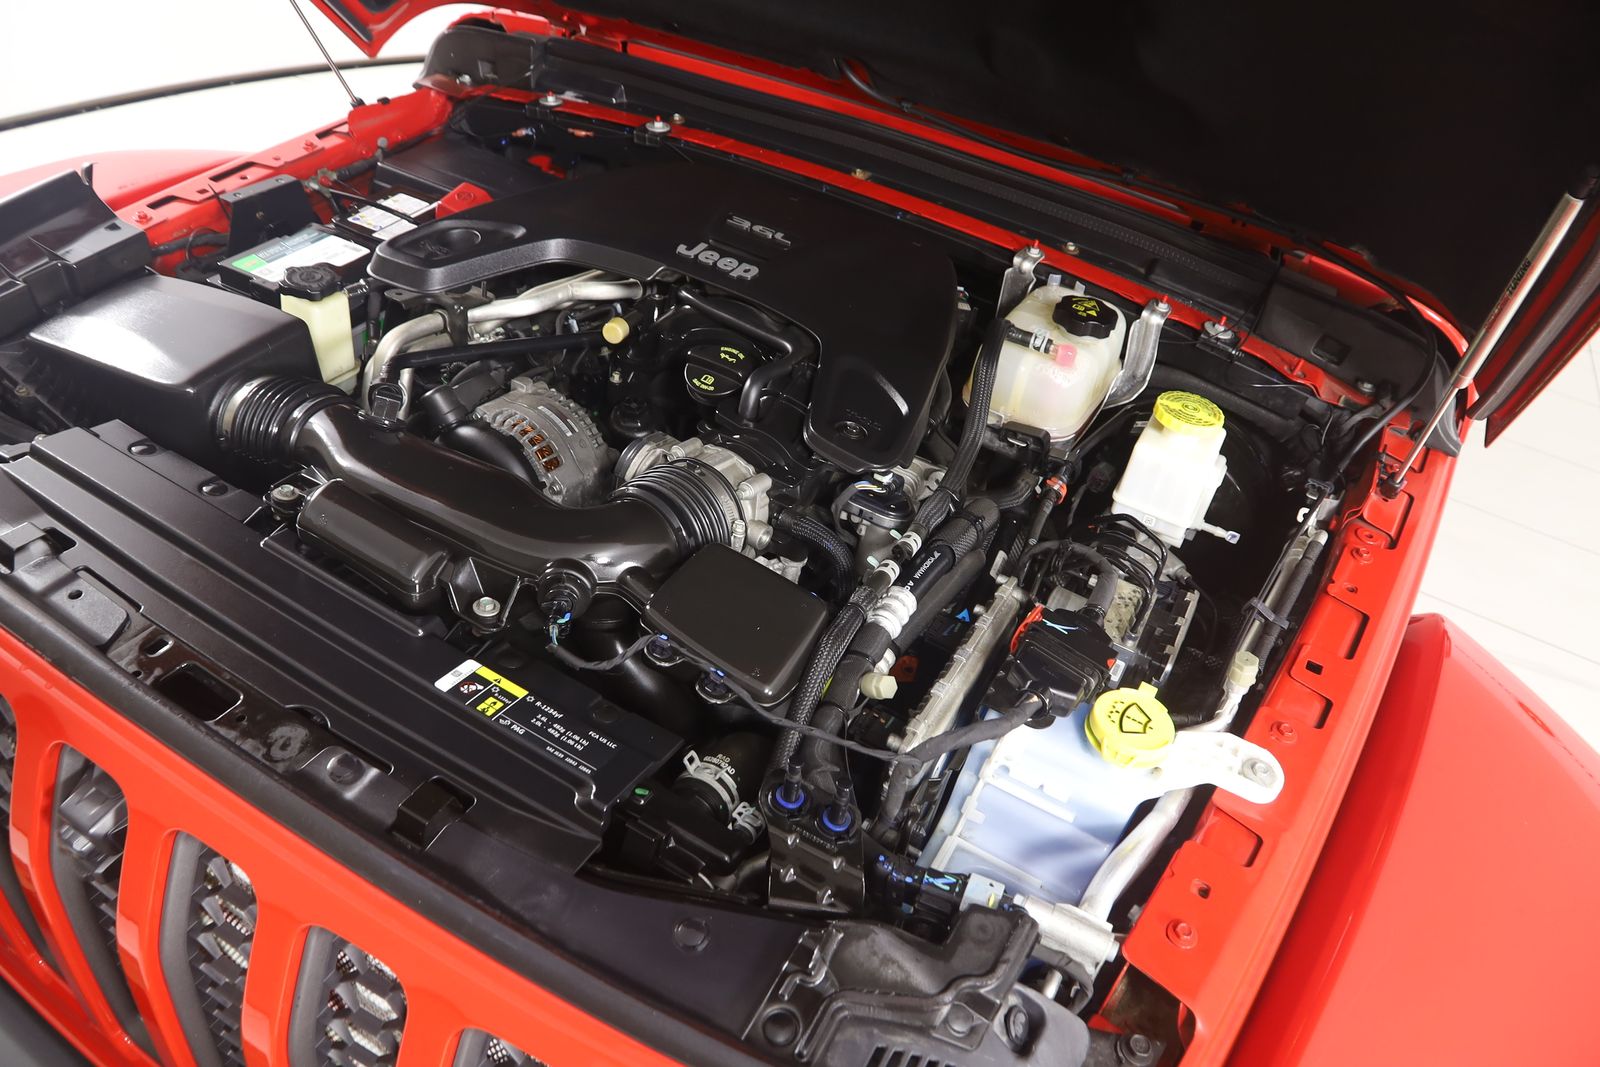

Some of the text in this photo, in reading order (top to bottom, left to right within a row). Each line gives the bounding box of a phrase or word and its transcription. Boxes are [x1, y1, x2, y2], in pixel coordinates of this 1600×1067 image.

[675, 242, 760, 280] Jeep
[913, 554, 939, 579] YOKOHAMA
[534, 701, 564, 719] R-1234yf
[511, 724, 526, 735] PAG
[588, 731, 600, 740] FCA
[606, 741, 618, 749] LLC
[716, 753, 731, 763] RAD
